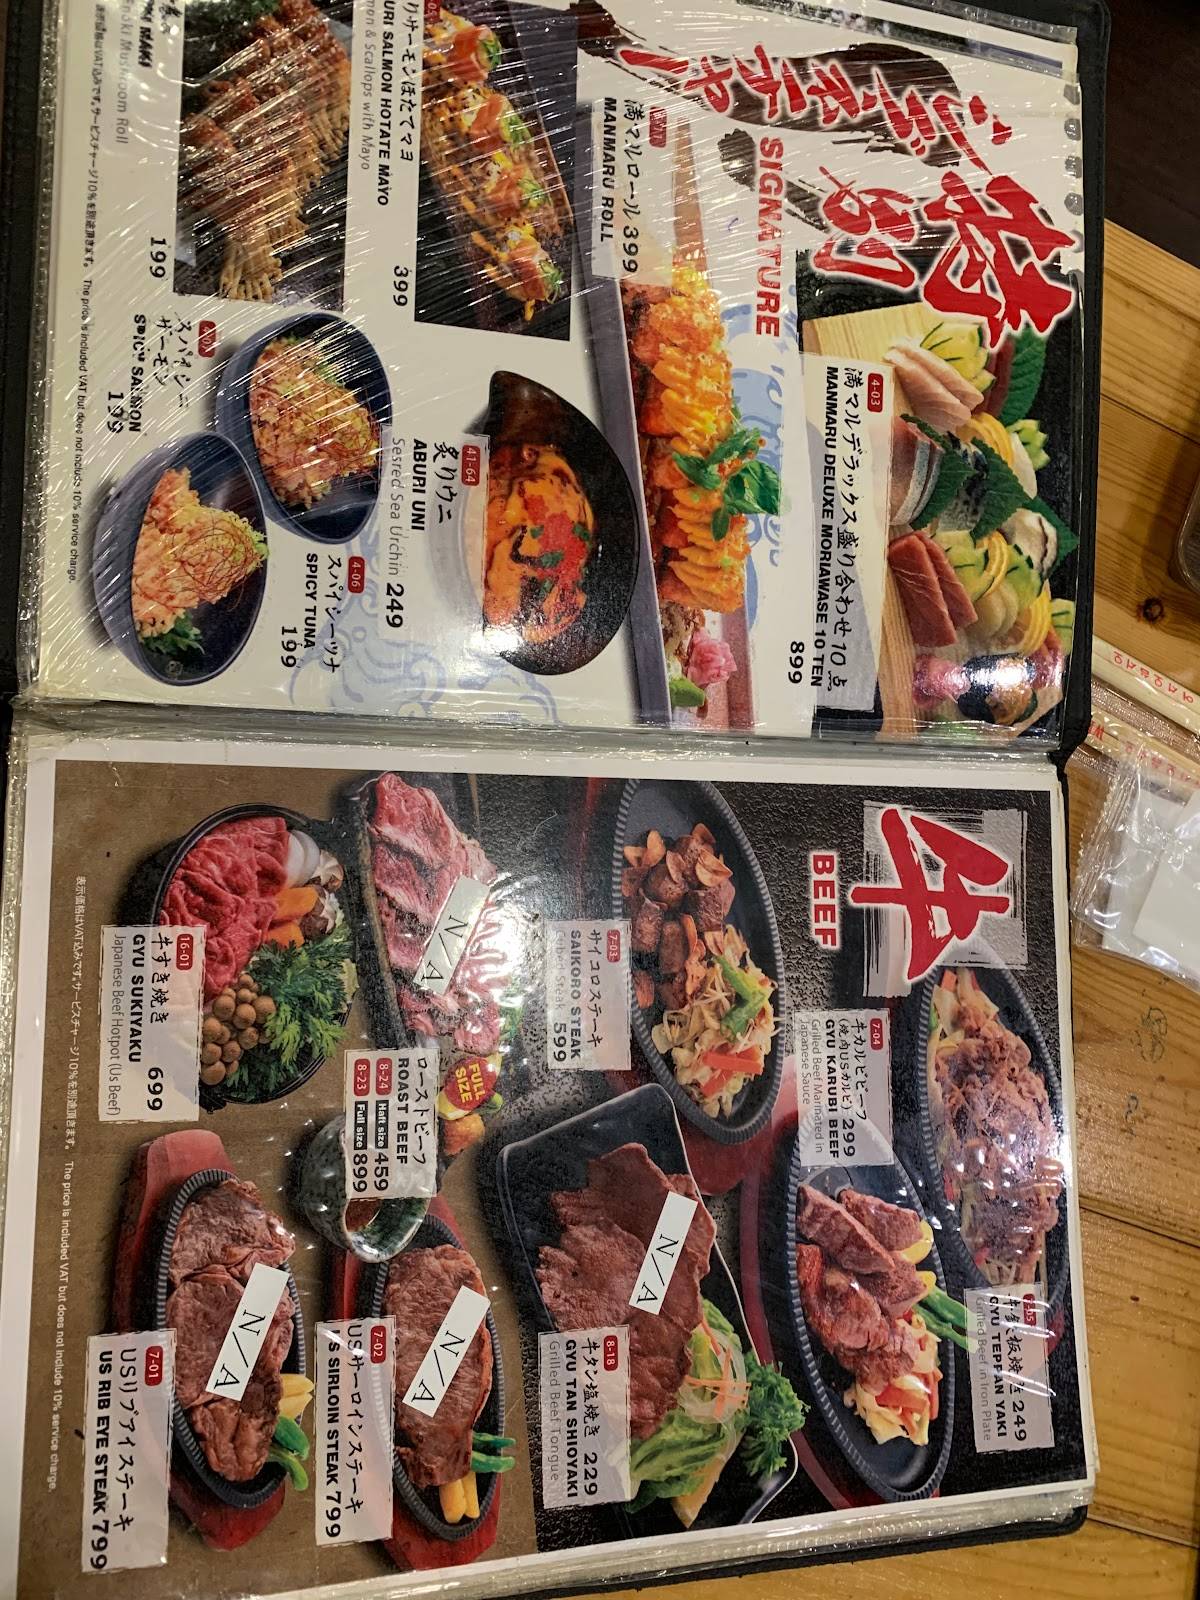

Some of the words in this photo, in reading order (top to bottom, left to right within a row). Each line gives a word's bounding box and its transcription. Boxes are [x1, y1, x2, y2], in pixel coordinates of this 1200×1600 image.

[137, 26, 153, 69] MAKI
[365, 29, 376, 39] &
[360, 43, 375, 98] Scallops
[380, 31, 394, 94] SALMON
[114, 117, 129, 145] Roll
[361, 102, 375, 131] with
[378, 98, 392, 160] HOTATE
[358, 135, 374, 171] Mayo
[602, 96, 617, 190] MANMARU
[376, 164, 391, 207] MAYO
[600, 196, 615, 243] ROLL
[755, 136, 784, 338] SIGNATURE
[149, 236, 167, 279] 199
[622, 225, 640, 274] 399
[82, 279, 93, 296] The
[392, 264, 410, 308] 399
[80, 298, 91, 321] price
[79, 333, 90, 372] included
[77, 395, 87, 410] but
[78, 374, 88, 393] VAT
[128, 366, 144, 433] SALMON
[869, 379, 881, 406] 4-03
[106, 391, 125, 434] 199
[824, 366, 839, 449] MANMARU
[75, 436, 84, 451] not
[391, 438, 406, 489] Sesred
[412, 438, 428, 494] ABURI
[432, 441, 460, 524] 炙りウニ
[464, 447, 477, 483] 41-64
[72, 490, 82, 511] 10%
[390, 493, 404, 520] Sea
[821, 453, 838, 520] DELUXE
[70, 513, 81, 547] service
[410, 500, 426, 531] UNI
[67, 549, 79, 584] charge.
[388, 525, 403, 577] Urchin
[304, 552, 318, 601] SPICY
[350, 561, 361, 588] 4-06
[815, 523, 834, 624] MORIAWASE
[321, 554, 344, 674] スパイシーツナ
[385, 582, 405, 629] 249
[280, 625, 298, 669] 199
[303, 605, 317, 650] TUNA
[812, 629, 827, 650] 10
[788, 640, 805, 685] 899
[810, 654, 826, 688] TEN
[812, 853, 837, 948] BEEF
[850, 808, 1011, 981] 牛
[110, 934, 126, 988] Japanese
[132, 934, 146, 968] GYU
[179, 936, 190, 967] 16-01
[420, 915, 469, 982] N/A
[570, 929, 582, 1000] SAIKORO
[609, 934, 618, 957] 7-03
[150, 932, 173, 1025] 牛すき焼き
[587, 928, 603, 1048] サイコロステーキ
[112, 990, 125, 1016] Beef
[128, 975, 145, 1063] SUKIYAKU
[107, 1018, 122, 1060] Hotpot
[552, 1021, 567, 1063] 599
[570, 1006, 582, 1060] STEAK
[798, 1019, 811, 1070] Japanese
[810, 1018, 823, 1055] Grilled
[824, 1018, 837, 1050] GYU
[871, 1022, 881, 1046] 7-04
[107, 1063, 121, 1083] (Us
[146, 1066, 164, 1112] 699
[356, 1063, 368, 1091] 8-23
[378, 1062, 390, 1090] 8-24
[397, 1057, 410, 1114] ROAST
[454, 1066, 473, 1104] SIZE
[468, 1062, 486, 1102] FULL
[801, 1072, 812, 1105] Sauce
[812, 1056, 824, 1082] Beef
[826, 1054, 839, 1113] KARUBI
[850, 1017, 868, 1121] 牛カルビビーフ
[105, 1085, 121, 1117] Beef)
[355, 1103, 366, 1124] Full
[377, 1103, 387, 1124] Haft
[412, 1057, 431, 1166] ローストビーフ
[813, 1083, 825, 1141] Marinated
[354, 1126, 365, 1148] size
[375, 1126, 387, 1147] size
[396, 1120, 409, 1165] BEEF
[814, 1142, 824, 1154] in
[828, 1118, 840, 1159] BEEF
[842, 1117, 856, 1158] 299
[63, 1161, 75, 1180] The
[352, 1152, 368, 1194] 899
[374, 1152, 389, 1192] 459
[60, 1182, 74, 1206] price
[62, 1208, 73, 1217] is
[60, 1219, 72, 1261] included
[59, 1262, 70, 1283] VAT
[636, 1233, 679, 1305] N/A
[58, 1285, 69, 1302] but
[988, 1296, 1000, 1327] GYU
[56, 1304, 68, 1329] does
[55, 1331, 66, 1348] not
[213, 1309, 267, 1391] N/A
[373, 1331, 384, 1357] 7-02
[565, 1339, 578, 1373] GYU
[605, 1339, 616, 1367] 8-18
[977, 1338, 990, 1365] Beef
[53, 1350, 65, 1386] include
[98, 1350, 113, 1375] US
[148, 1351, 159, 1379] 7-01
[410, 1330, 466, 1405] N/A
[549, 1339, 562, 1388] Grilled
[978, 1369, 989, 1381] in
[990, 1332, 1004, 1396] TEPPAN
[52, 1388, 64, 1412] 10%
[96, 1380, 111, 1410] RIB
[327, 1357, 340, 1424] SIRLOIN
[550, 1391, 562, 1423] Beef
[566, 1378, 578, 1412] TAN
[581, 1336, 601, 1439] 牛タン塩焼き
[979, 1383, 991, 1407] Iron
[49, 1413, 61, 1451] service
[95, 1416, 110, 1450] EYE
[981, 1410, 993, 1442] Plate
[995, 1400, 1008, 1438] YAKI
[1012, 1400, 1028, 1442] 249
[112, 1347, 139, 1532] USリブアイステーキ
[326, 1429, 339, 1486] STEAK
[547, 1424, 561, 1482] Tongue
[565, 1418, 579, 1499] SHIOYAKI
[46, 1453, 60, 1493] charge.
[92, 1454, 109, 1515] STEAK
[583, 1451, 598, 1497] 229
[325, 1490, 342, 1539] 799
[89, 1519, 109, 1570] 799
